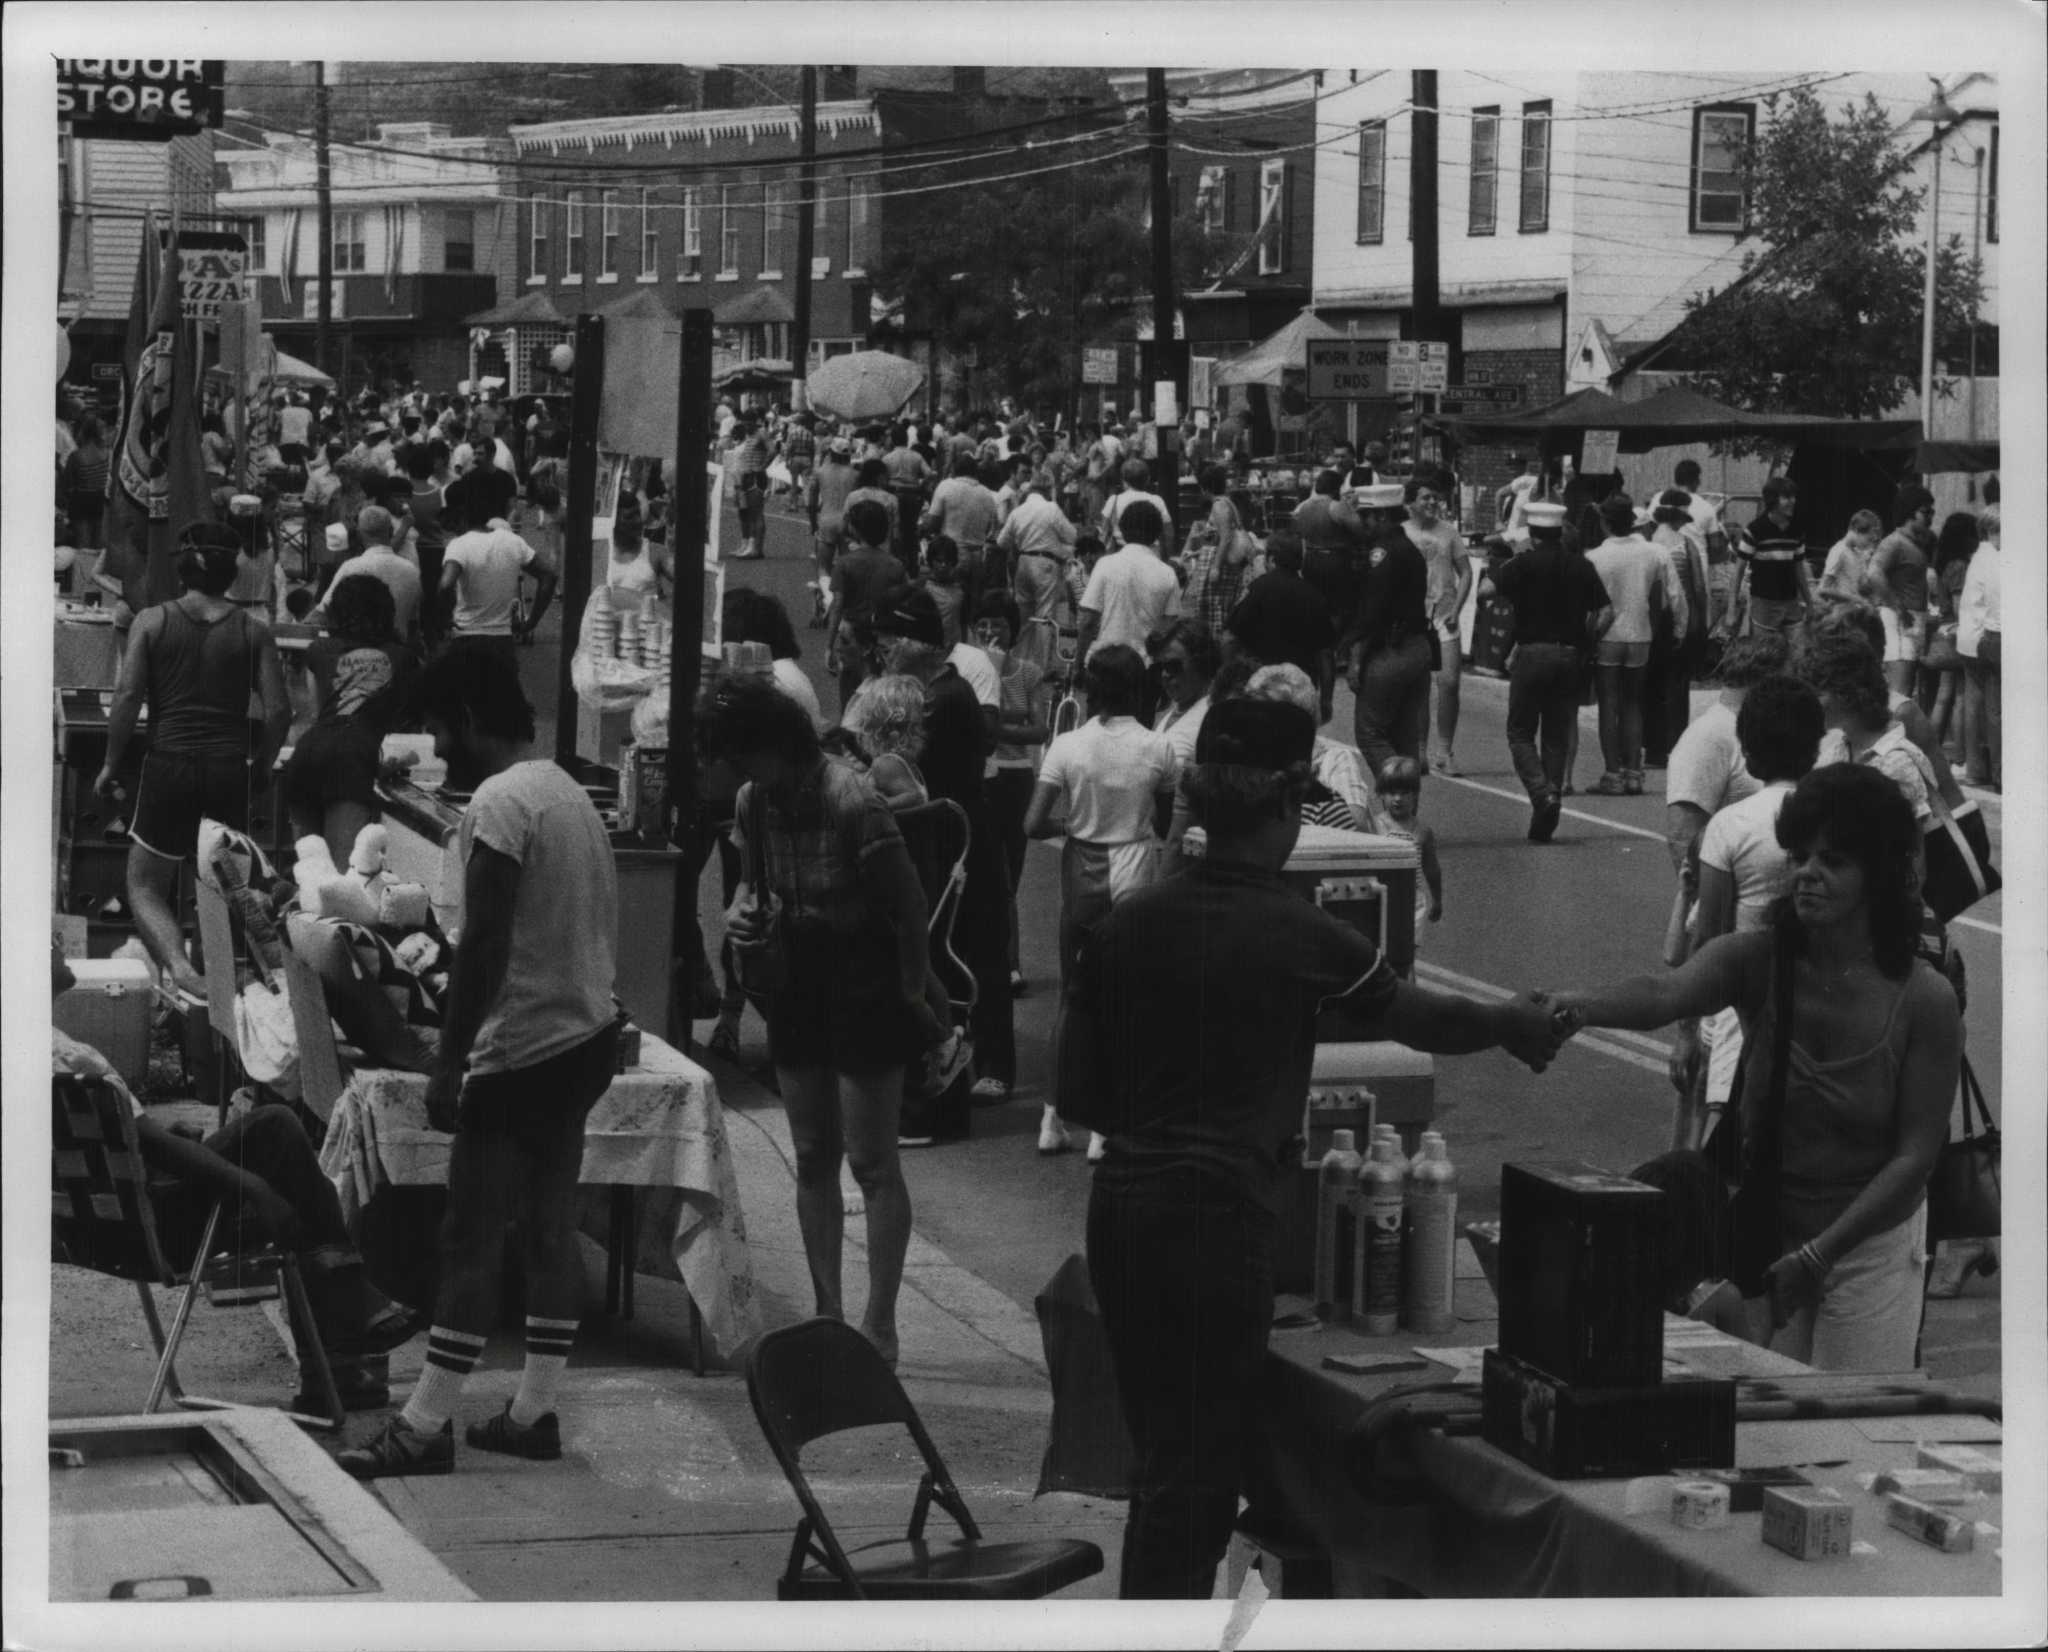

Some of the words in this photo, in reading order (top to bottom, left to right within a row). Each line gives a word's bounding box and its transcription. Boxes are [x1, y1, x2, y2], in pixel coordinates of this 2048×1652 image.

[57, 59, 203, 82] IQUOR
[57, 83, 193, 118] STORE
[1314, 351, 1349, 366] WORK
[1357, 351, 1388, 366] ZONE
[1334, 374, 1370, 389] ENDS
